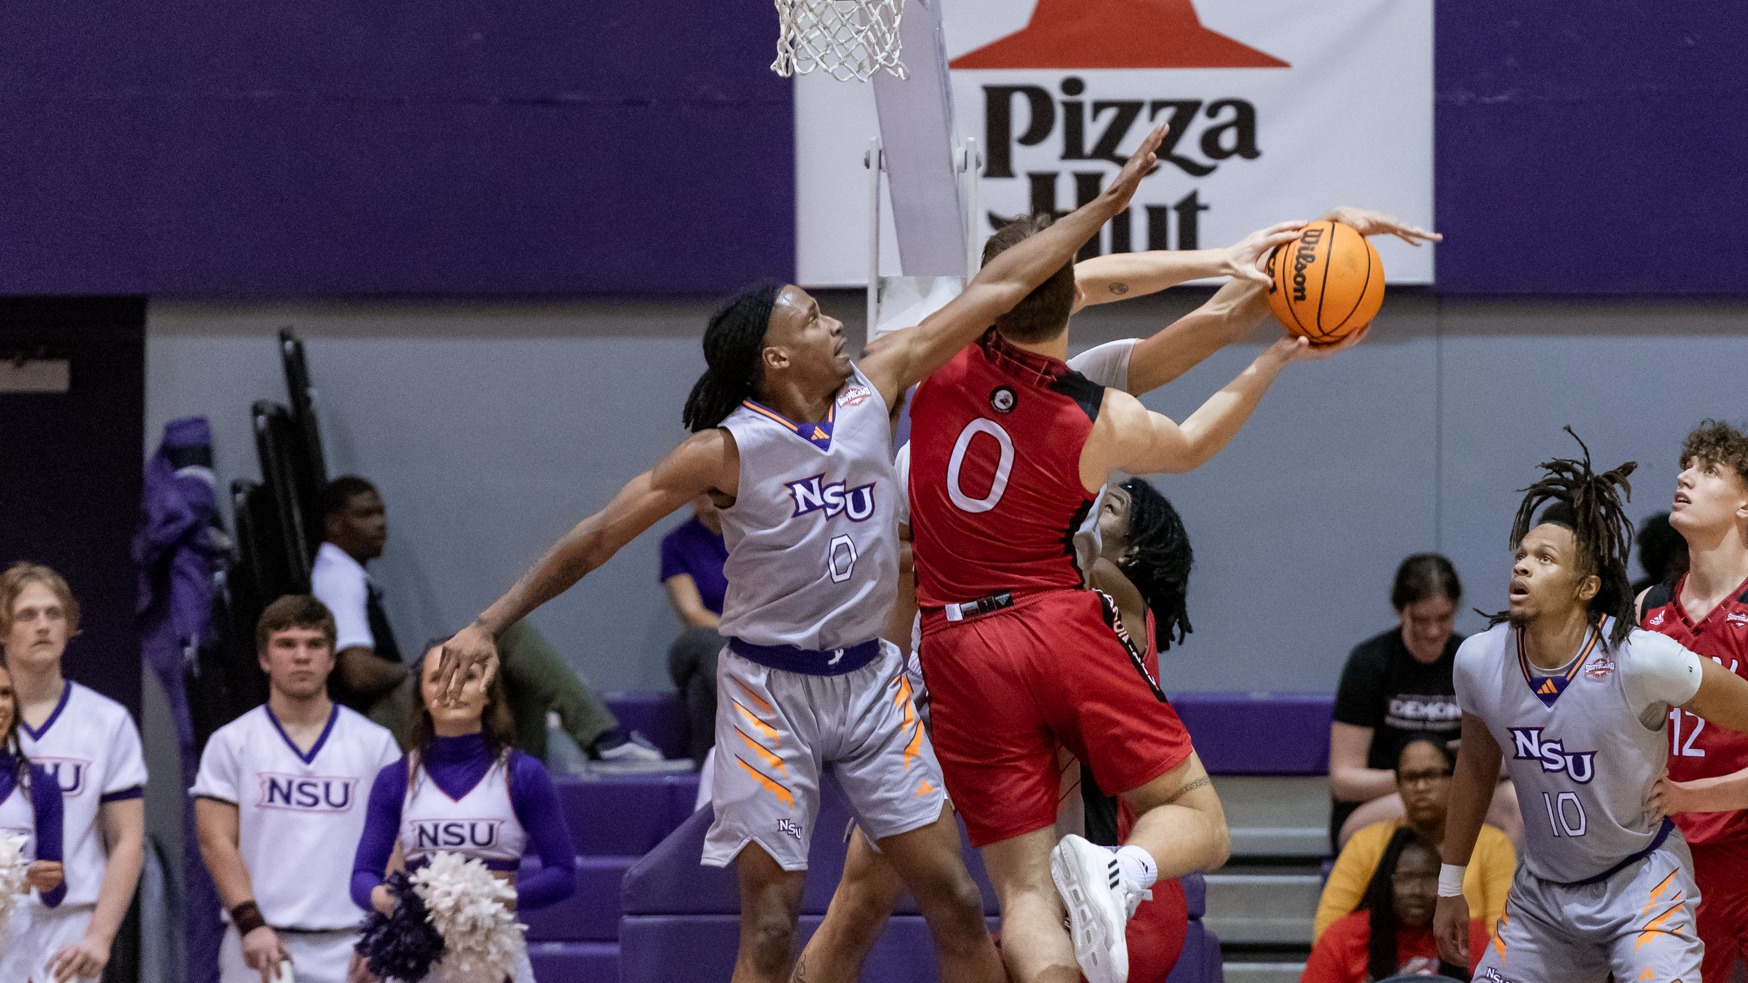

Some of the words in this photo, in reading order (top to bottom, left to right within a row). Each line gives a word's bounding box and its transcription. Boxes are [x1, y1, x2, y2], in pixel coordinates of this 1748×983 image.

[981, 76, 1262, 178] Pizza
[1293, 228, 1324, 304] Wilson
[946, 416, 1015, 514] 0
[784, 472, 877, 523] NSU
[827, 533, 859, 584] 0
[1506, 726, 1599, 785] NSU
[1669, 707, 1705, 758] 12
[267, 777, 351, 809] NSU
[1542, 791, 1588, 838] 10
[417, 822, 495, 849] NSU
[777, 818, 802, 839] NSU
